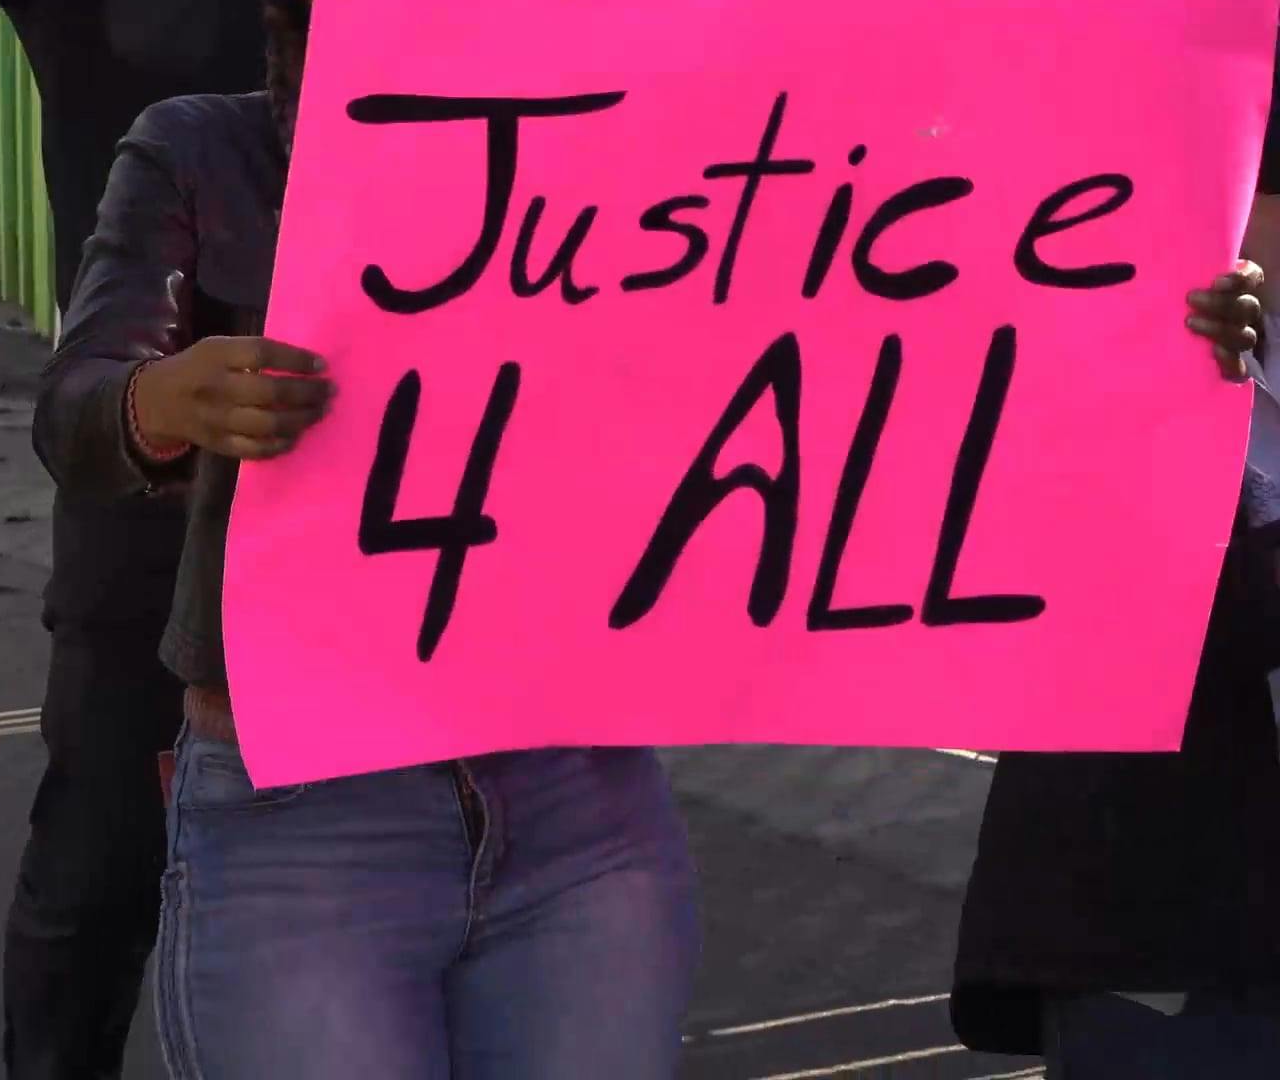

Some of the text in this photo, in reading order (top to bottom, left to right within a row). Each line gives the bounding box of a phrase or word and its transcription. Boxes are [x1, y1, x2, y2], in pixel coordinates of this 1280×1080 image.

[347, 91, 1137, 313] Justice
[358, 324, 1046, 662] 4 ALL
